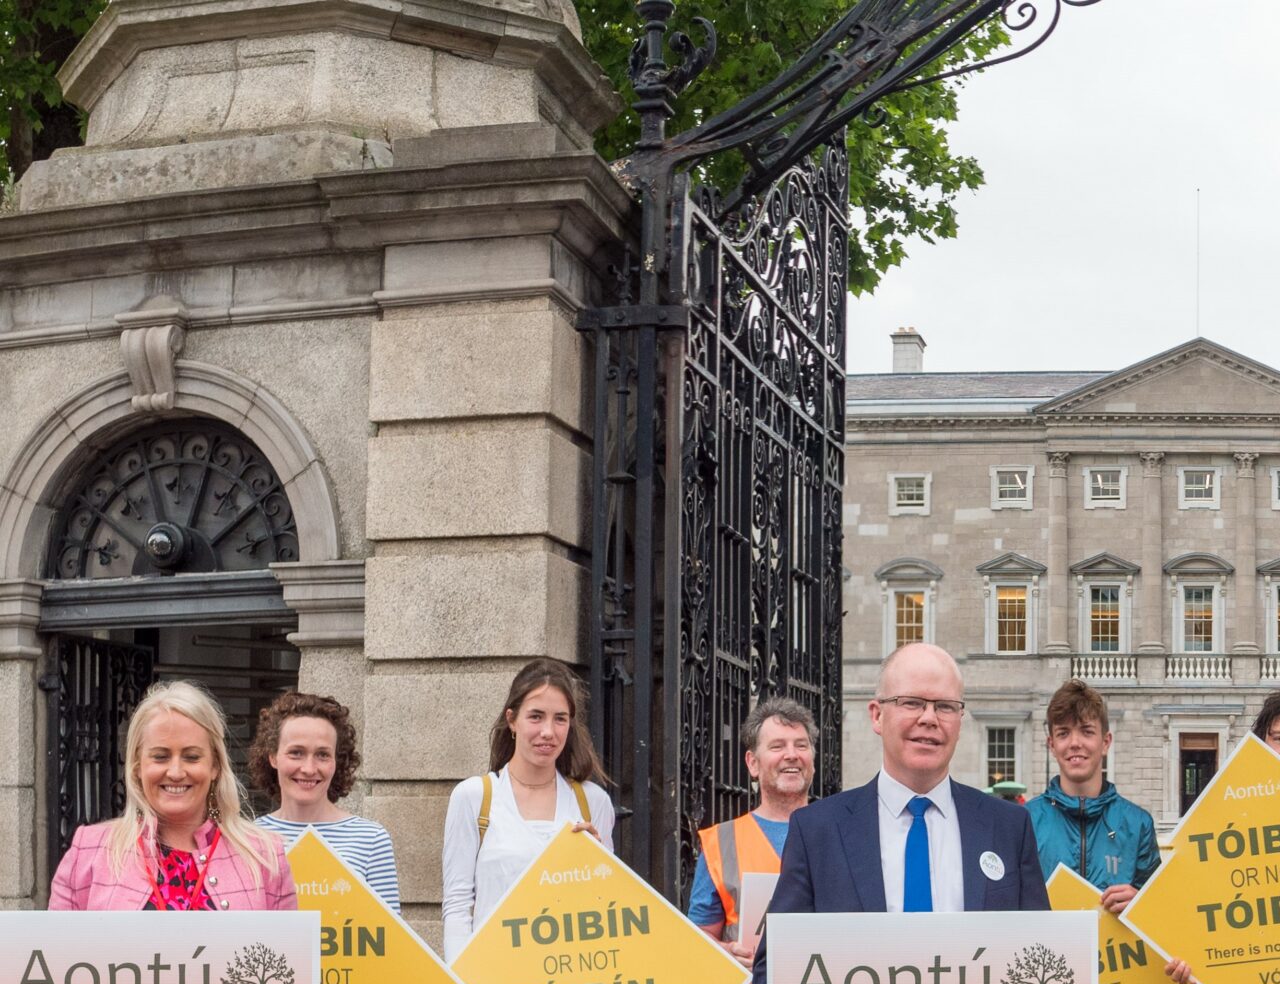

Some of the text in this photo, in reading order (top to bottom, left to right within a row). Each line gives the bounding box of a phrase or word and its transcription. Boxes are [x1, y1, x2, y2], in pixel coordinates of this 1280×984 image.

[1223, 780, 1275, 800] Aontú
[540, 865, 591, 886] Aontú
[1231, 867, 1260, 888] OR
[502, 901, 650, 948] TÓIBÍN
[320, 918, 385, 957] BÍN
[543, 949, 620, 975] OR NOT
[1205, 947, 1244, 960] There
[1249, 944, 1260, 955] is
